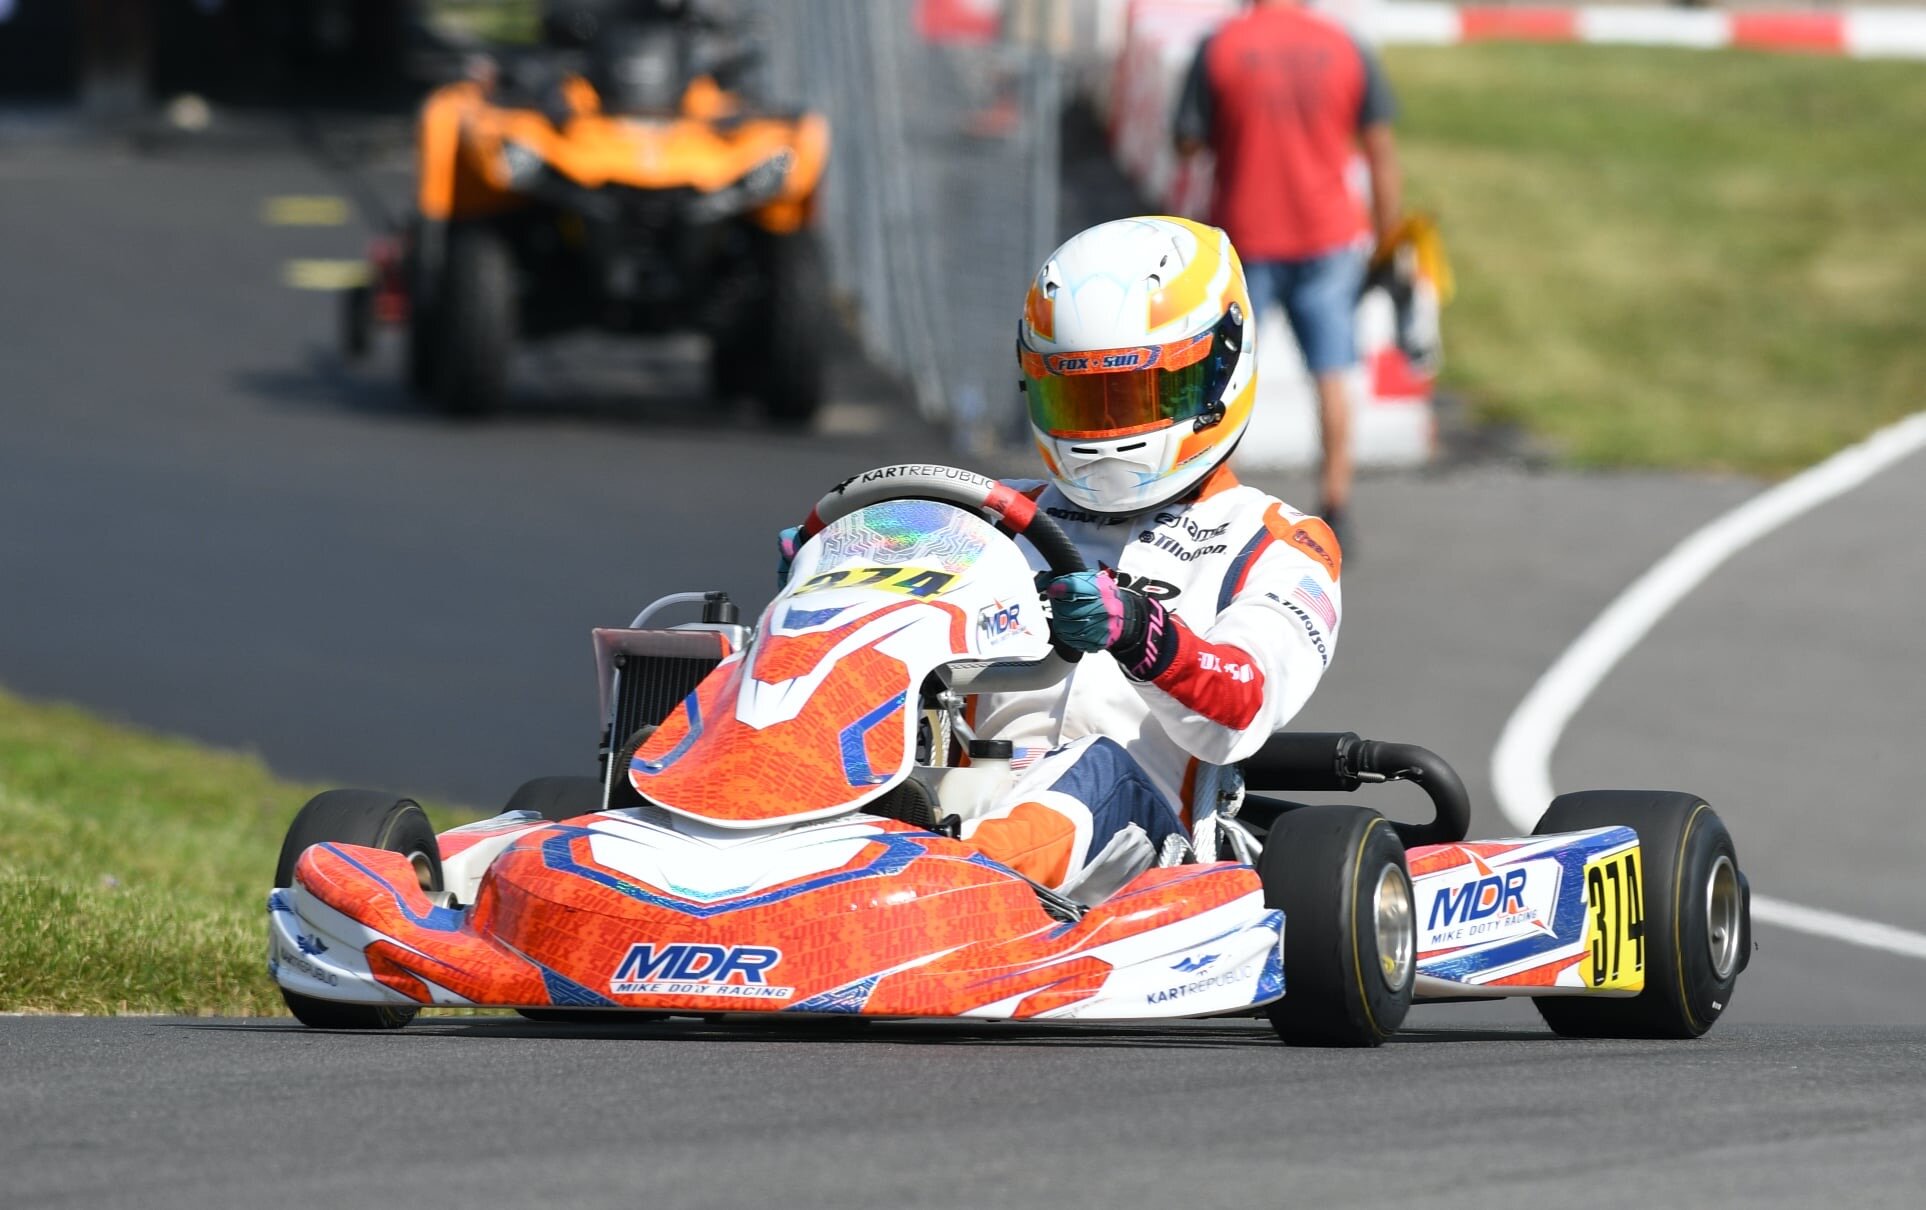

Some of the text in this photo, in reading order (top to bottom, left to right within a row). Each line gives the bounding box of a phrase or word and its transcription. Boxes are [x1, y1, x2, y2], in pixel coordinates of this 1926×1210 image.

[1058, 358, 1089, 370] FOX
[861, 465, 994, 490] KARTREPUBLIC
[1427, 867, 1528, 931] MDR
[1431, 909, 1537, 945] MIKE DOTY RACING
[1587, 854, 1645, 988] 374
[613, 944, 781, 985] MDR
[616, 983, 660, 993] MIKE
[719, 986, 788, 998] RACING
[1147, 965, 1252, 1005] KARTREPUBLIC
